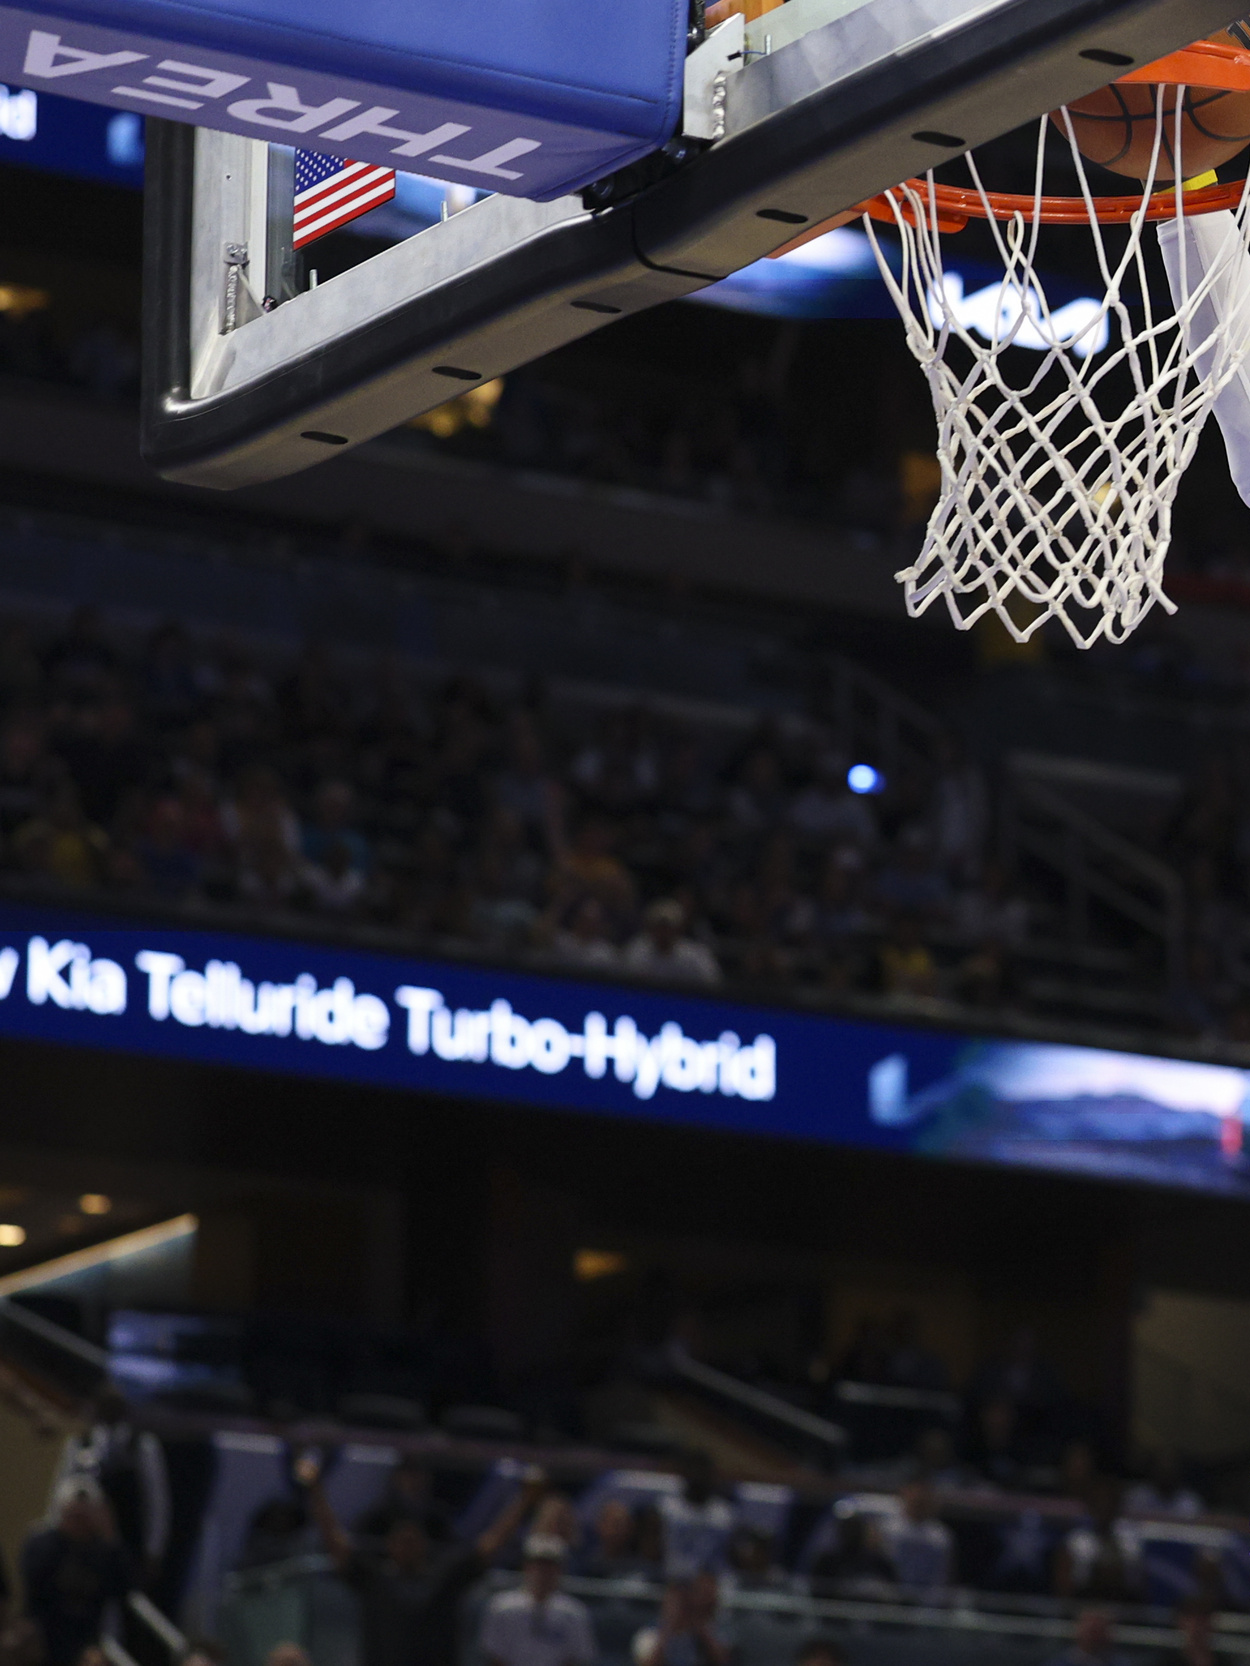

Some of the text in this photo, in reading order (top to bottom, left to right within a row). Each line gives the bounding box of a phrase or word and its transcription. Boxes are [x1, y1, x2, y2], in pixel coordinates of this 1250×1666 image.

[22, 30, 542, 181] THREA
[27, 936, 127, 1015] Kia
[135, 950, 391, 1050] Telluride
[395, 985, 777, 1101] Turbo-Hybrid
